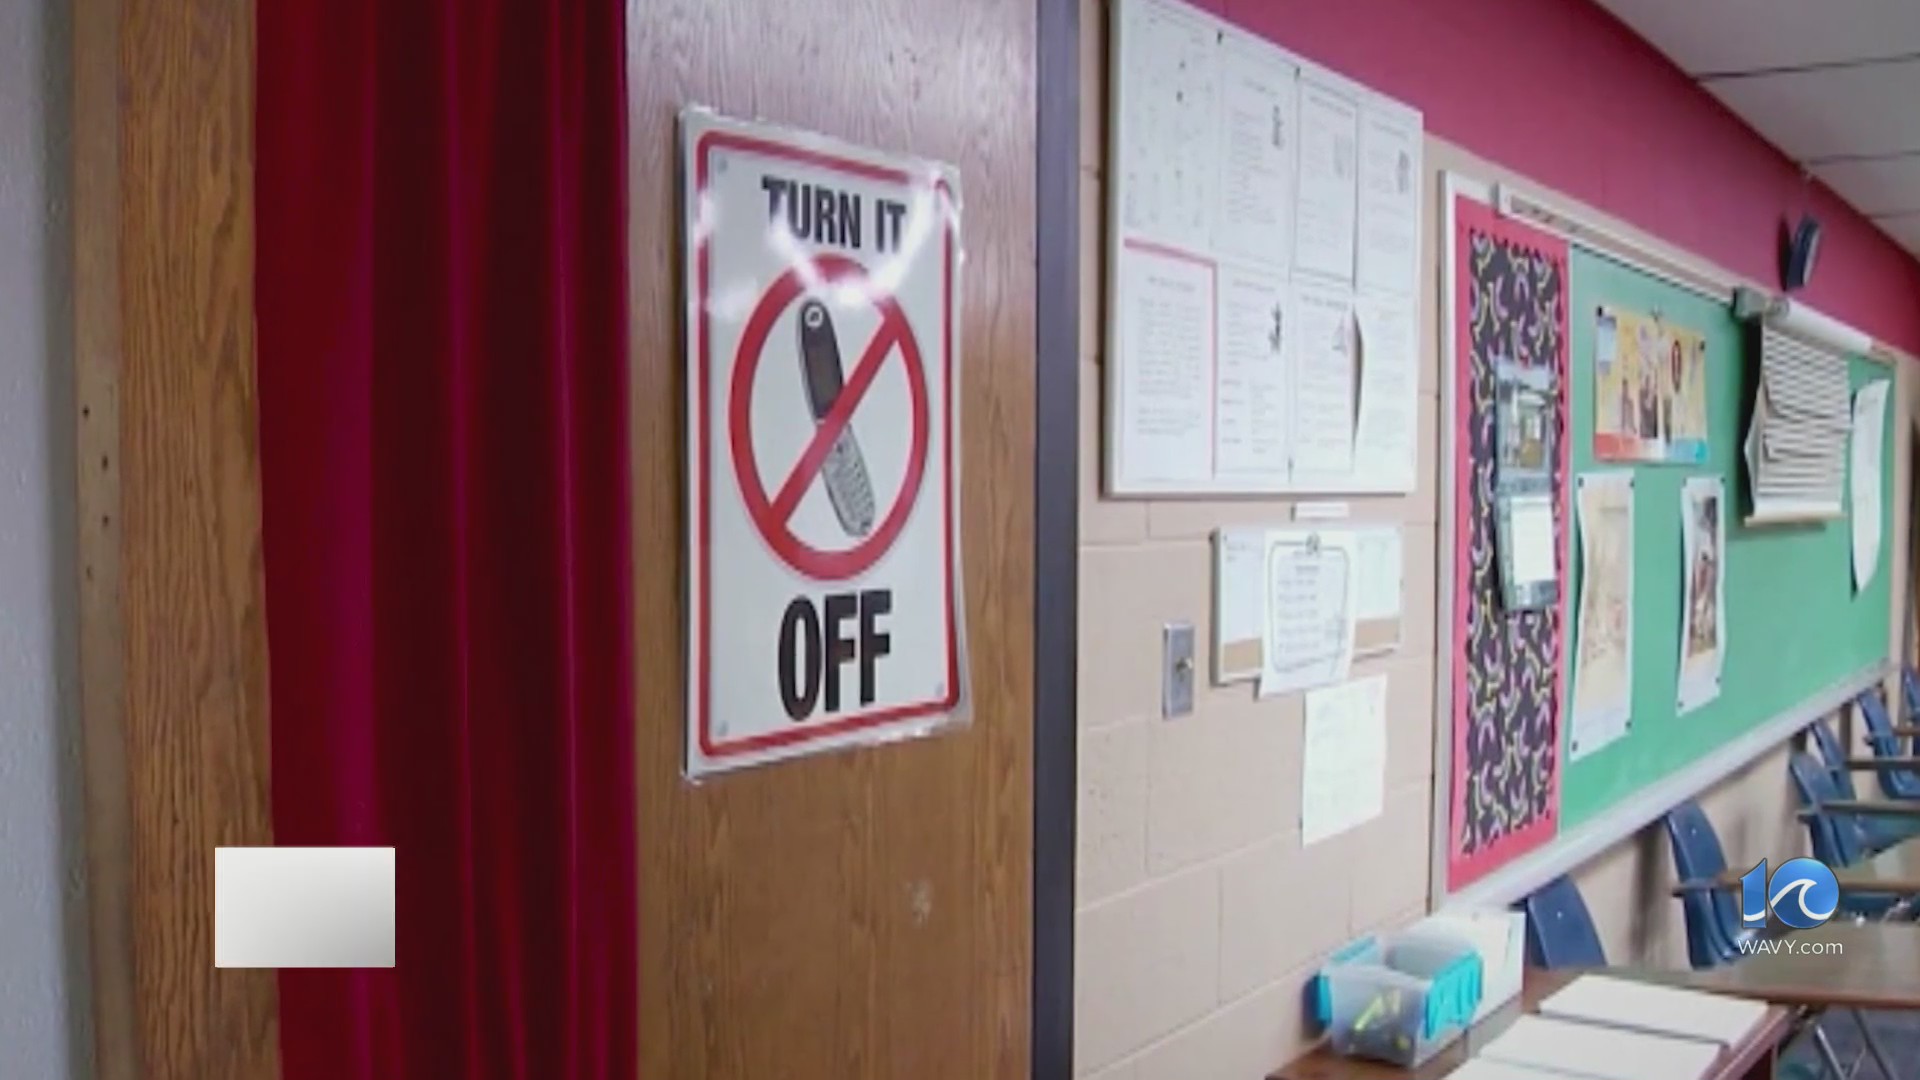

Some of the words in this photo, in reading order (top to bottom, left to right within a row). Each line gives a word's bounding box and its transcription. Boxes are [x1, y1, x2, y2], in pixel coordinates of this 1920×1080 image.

[762, 174, 860, 249] TURN
[876, 198, 906, 252] IT
[778, 589, 891, 721] OFF
